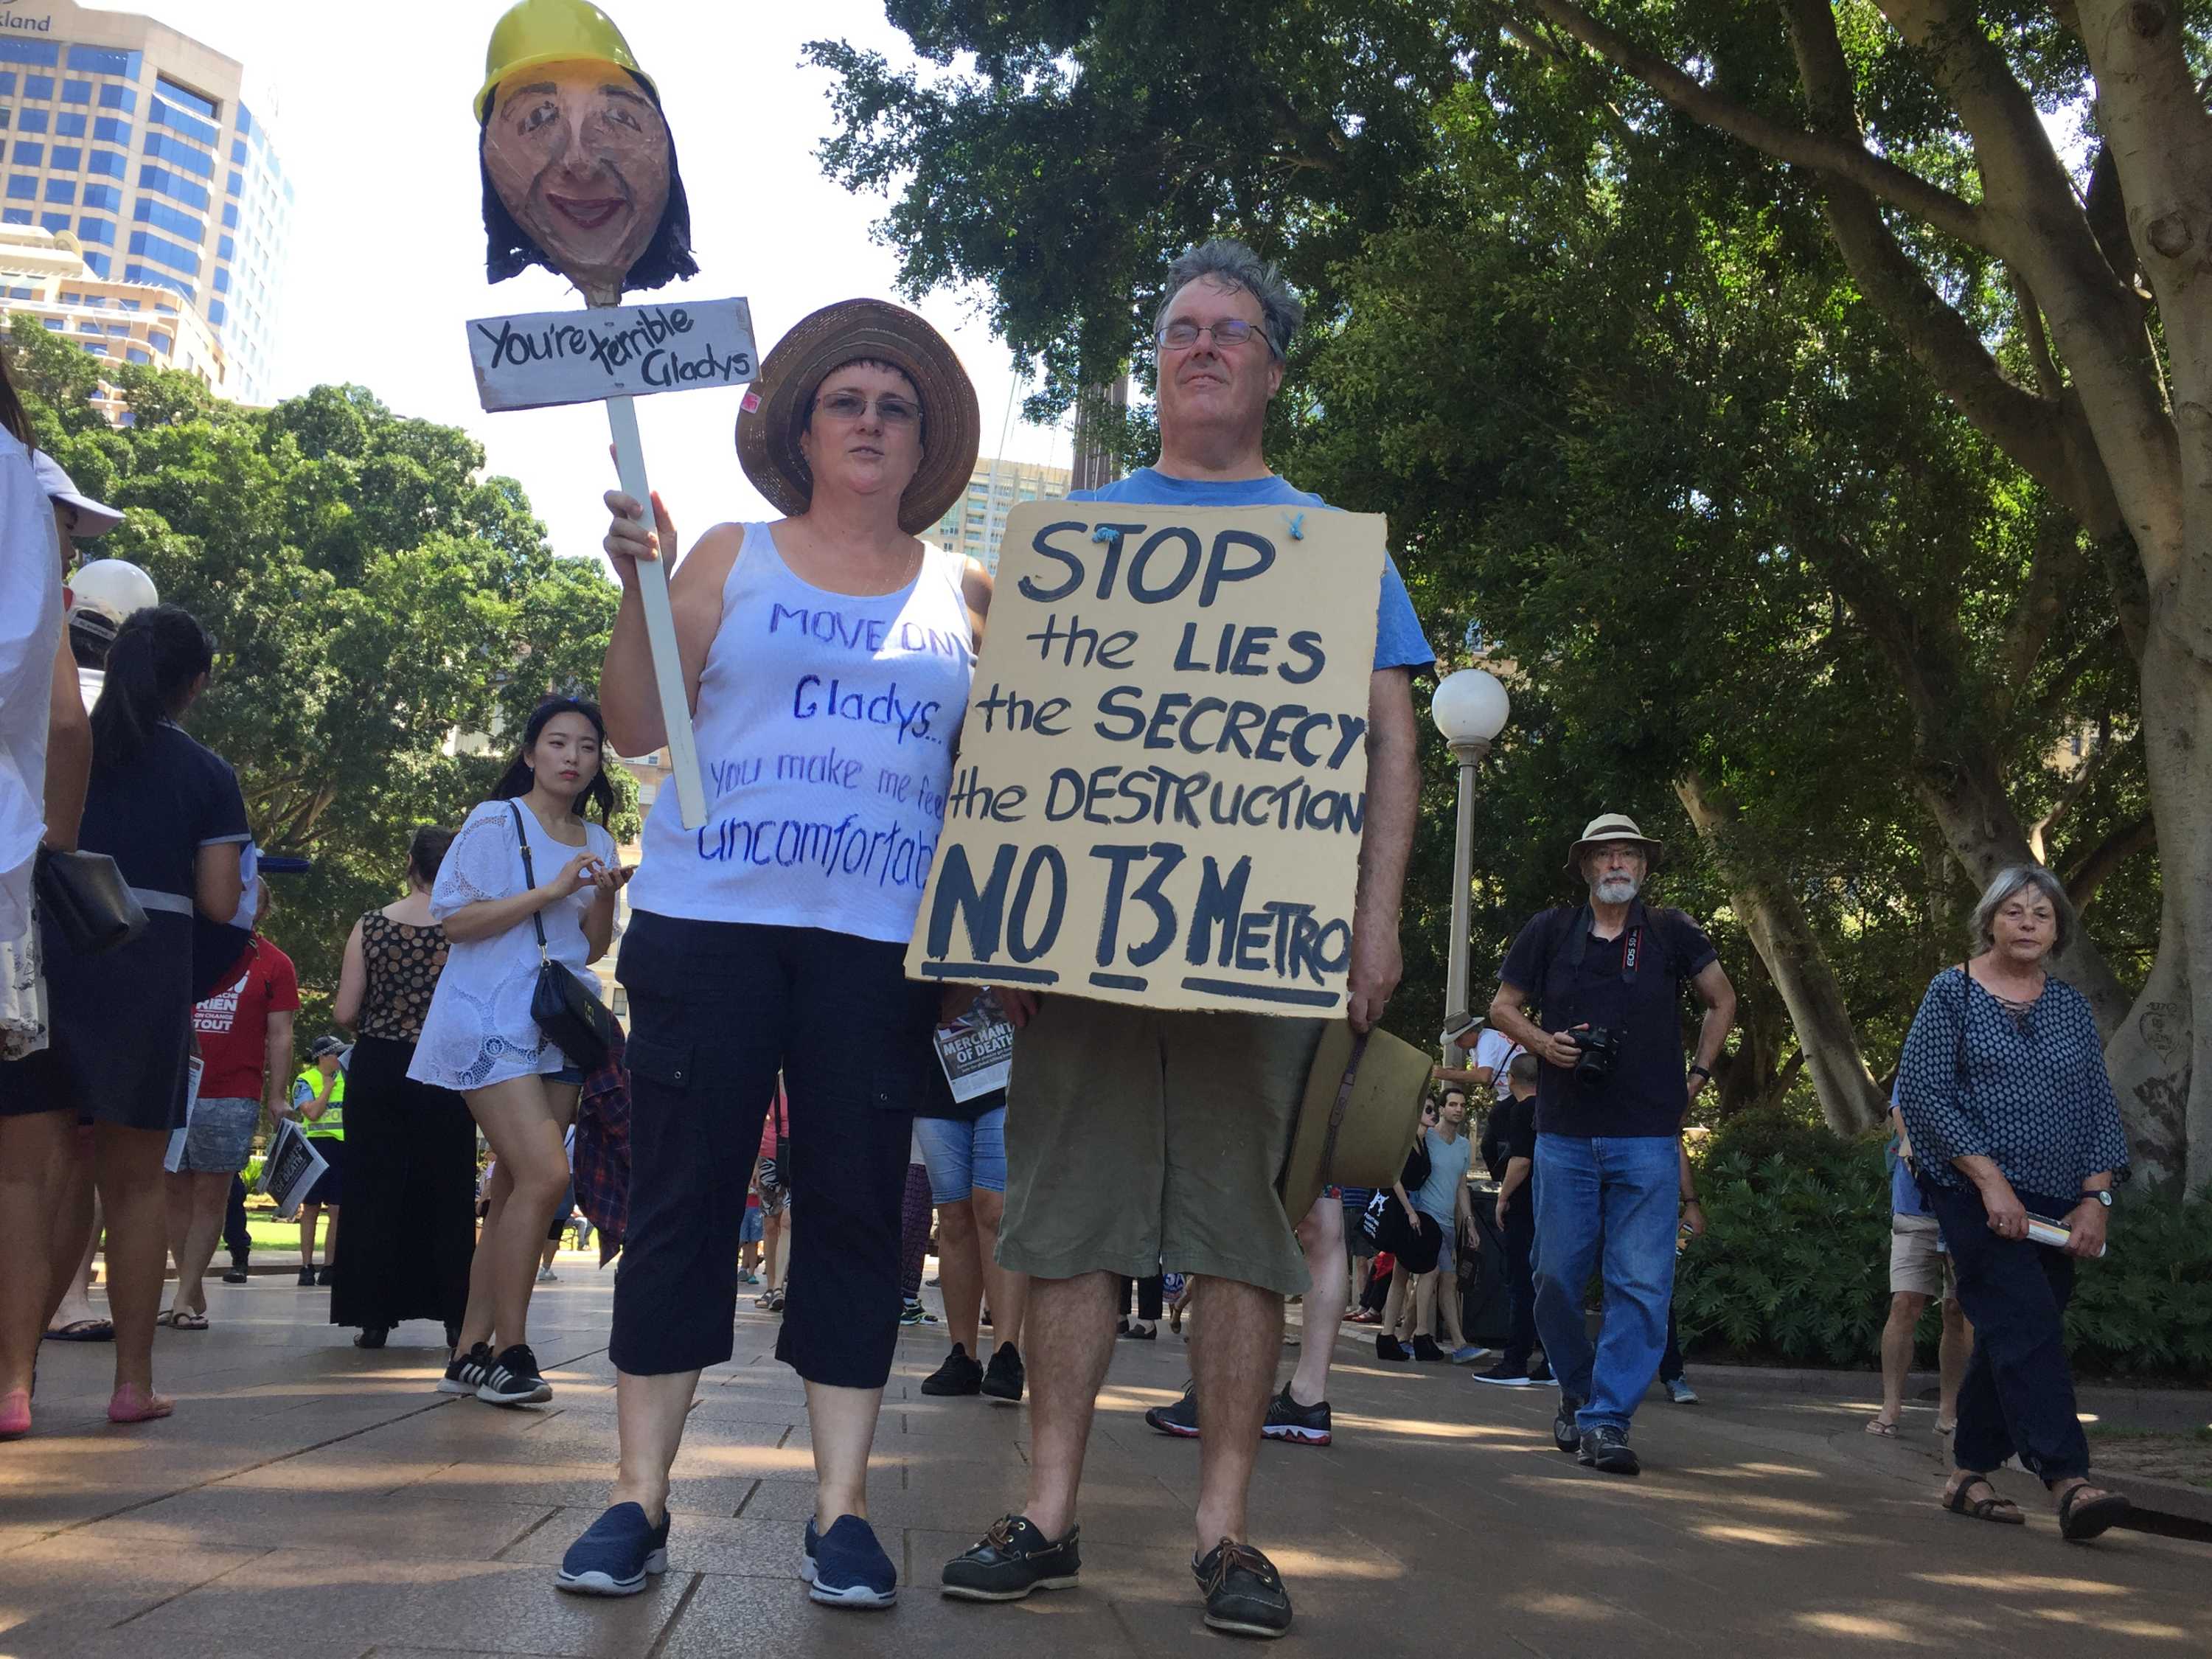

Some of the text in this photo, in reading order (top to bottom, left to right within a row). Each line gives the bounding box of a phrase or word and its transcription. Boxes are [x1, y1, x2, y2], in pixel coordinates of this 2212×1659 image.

[477, 307, 694, 375] You're terrible
[641, 344, 750, 386] Gladys
[1018, 521, 1276, 608] STOP
[769, 603, 885, 652] MOVE
[1026, 613, 1326, 684] the LIES
[975, 683, 1368, 771] the SECRECY
[777, 747, 862, 790] make
[877, 768, 911, 804] me
[950, 765, 1366, 835] the DESTRUCTION
[926, 844, 1068, 963] NO
[1089, 842, 1186, 968] T3
[1627, 948, 1635, 967] EOS
[193, 1019, 233, 1031] TOUT
[195, 998, 238, 1011] RIEN
[957, 1048, 973, 1062] OF
[975, 1034, 1013, 1056] DEATH
